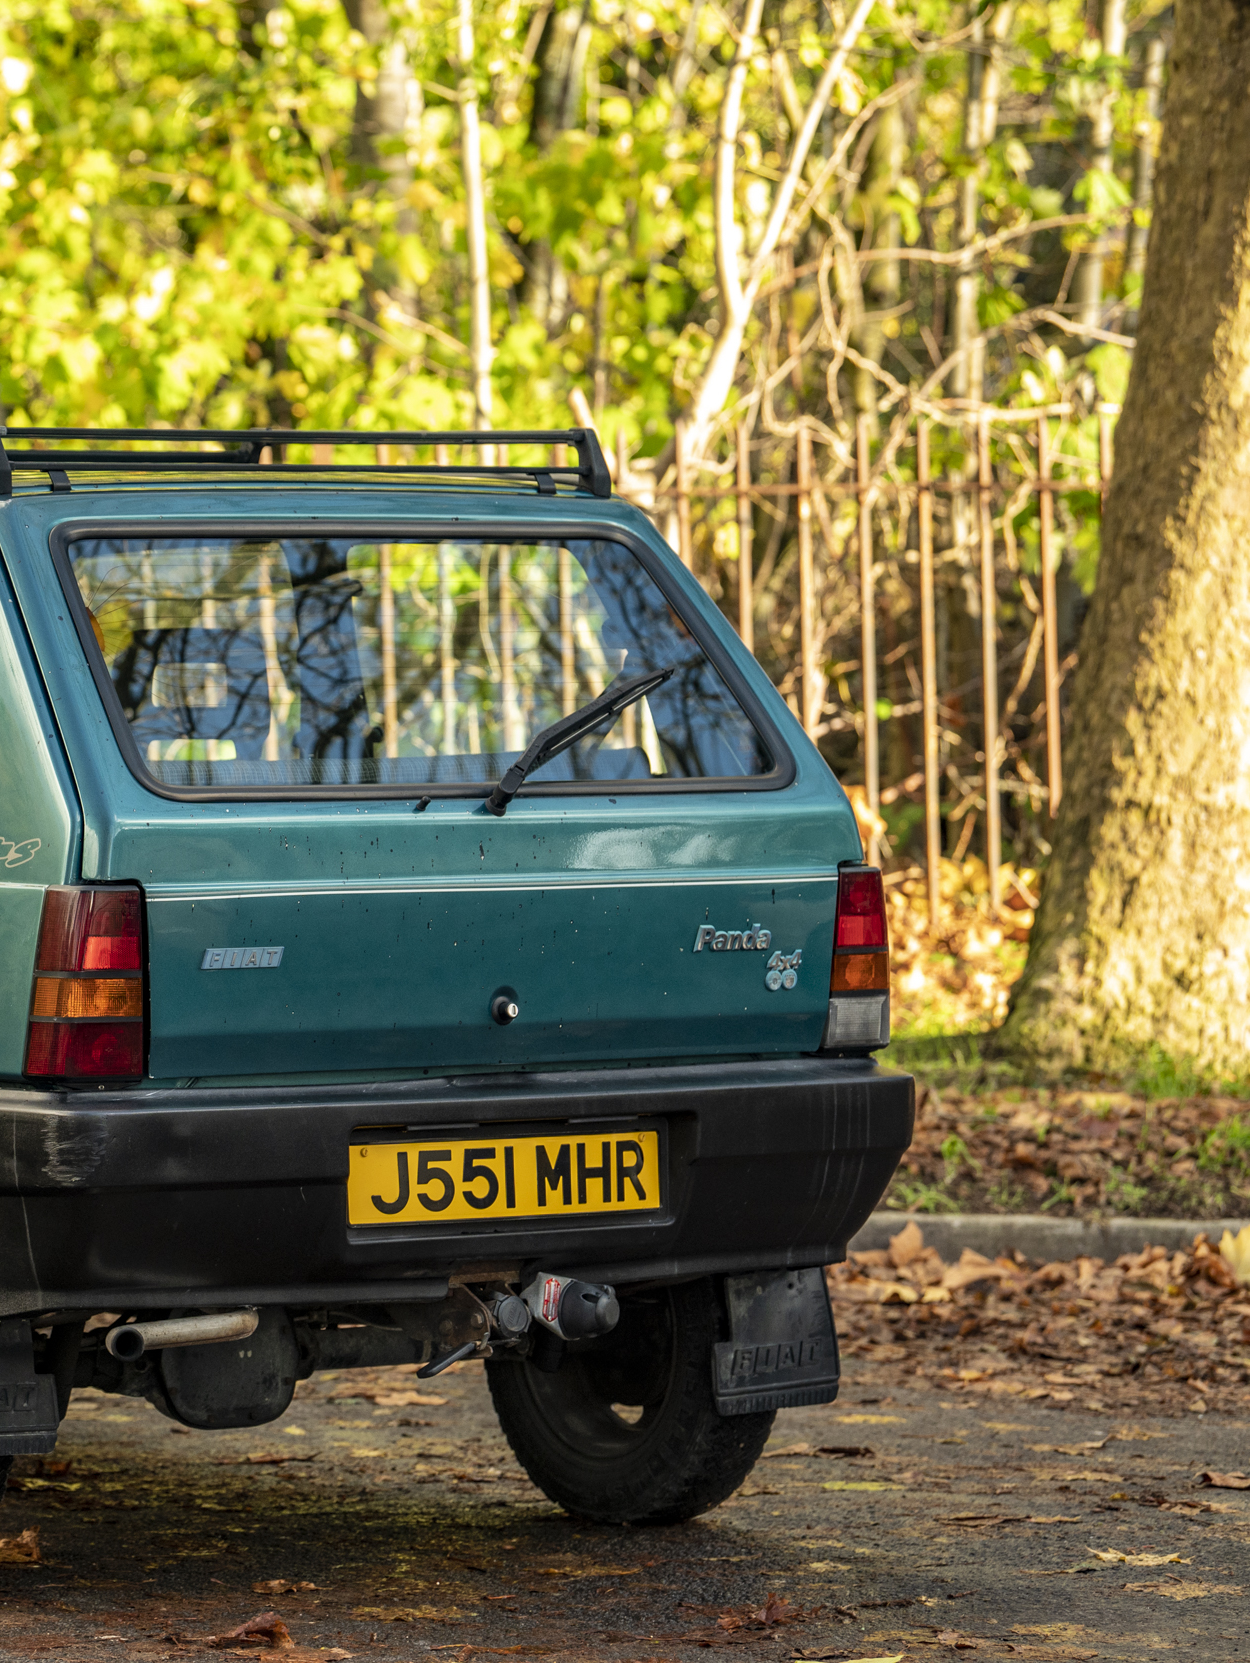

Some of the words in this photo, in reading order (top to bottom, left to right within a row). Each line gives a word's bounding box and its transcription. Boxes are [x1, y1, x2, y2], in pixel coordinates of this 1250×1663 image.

[693, 923, 771, 952] Panda
[207, 949, 280, 968] FIAT
[767, 949, 802, 970] 4x4
[371, 1145, 516, 1215] J551
[535, 1140, 647, 1207] MHR
[741, 1341, 820, 1370] FIAT
